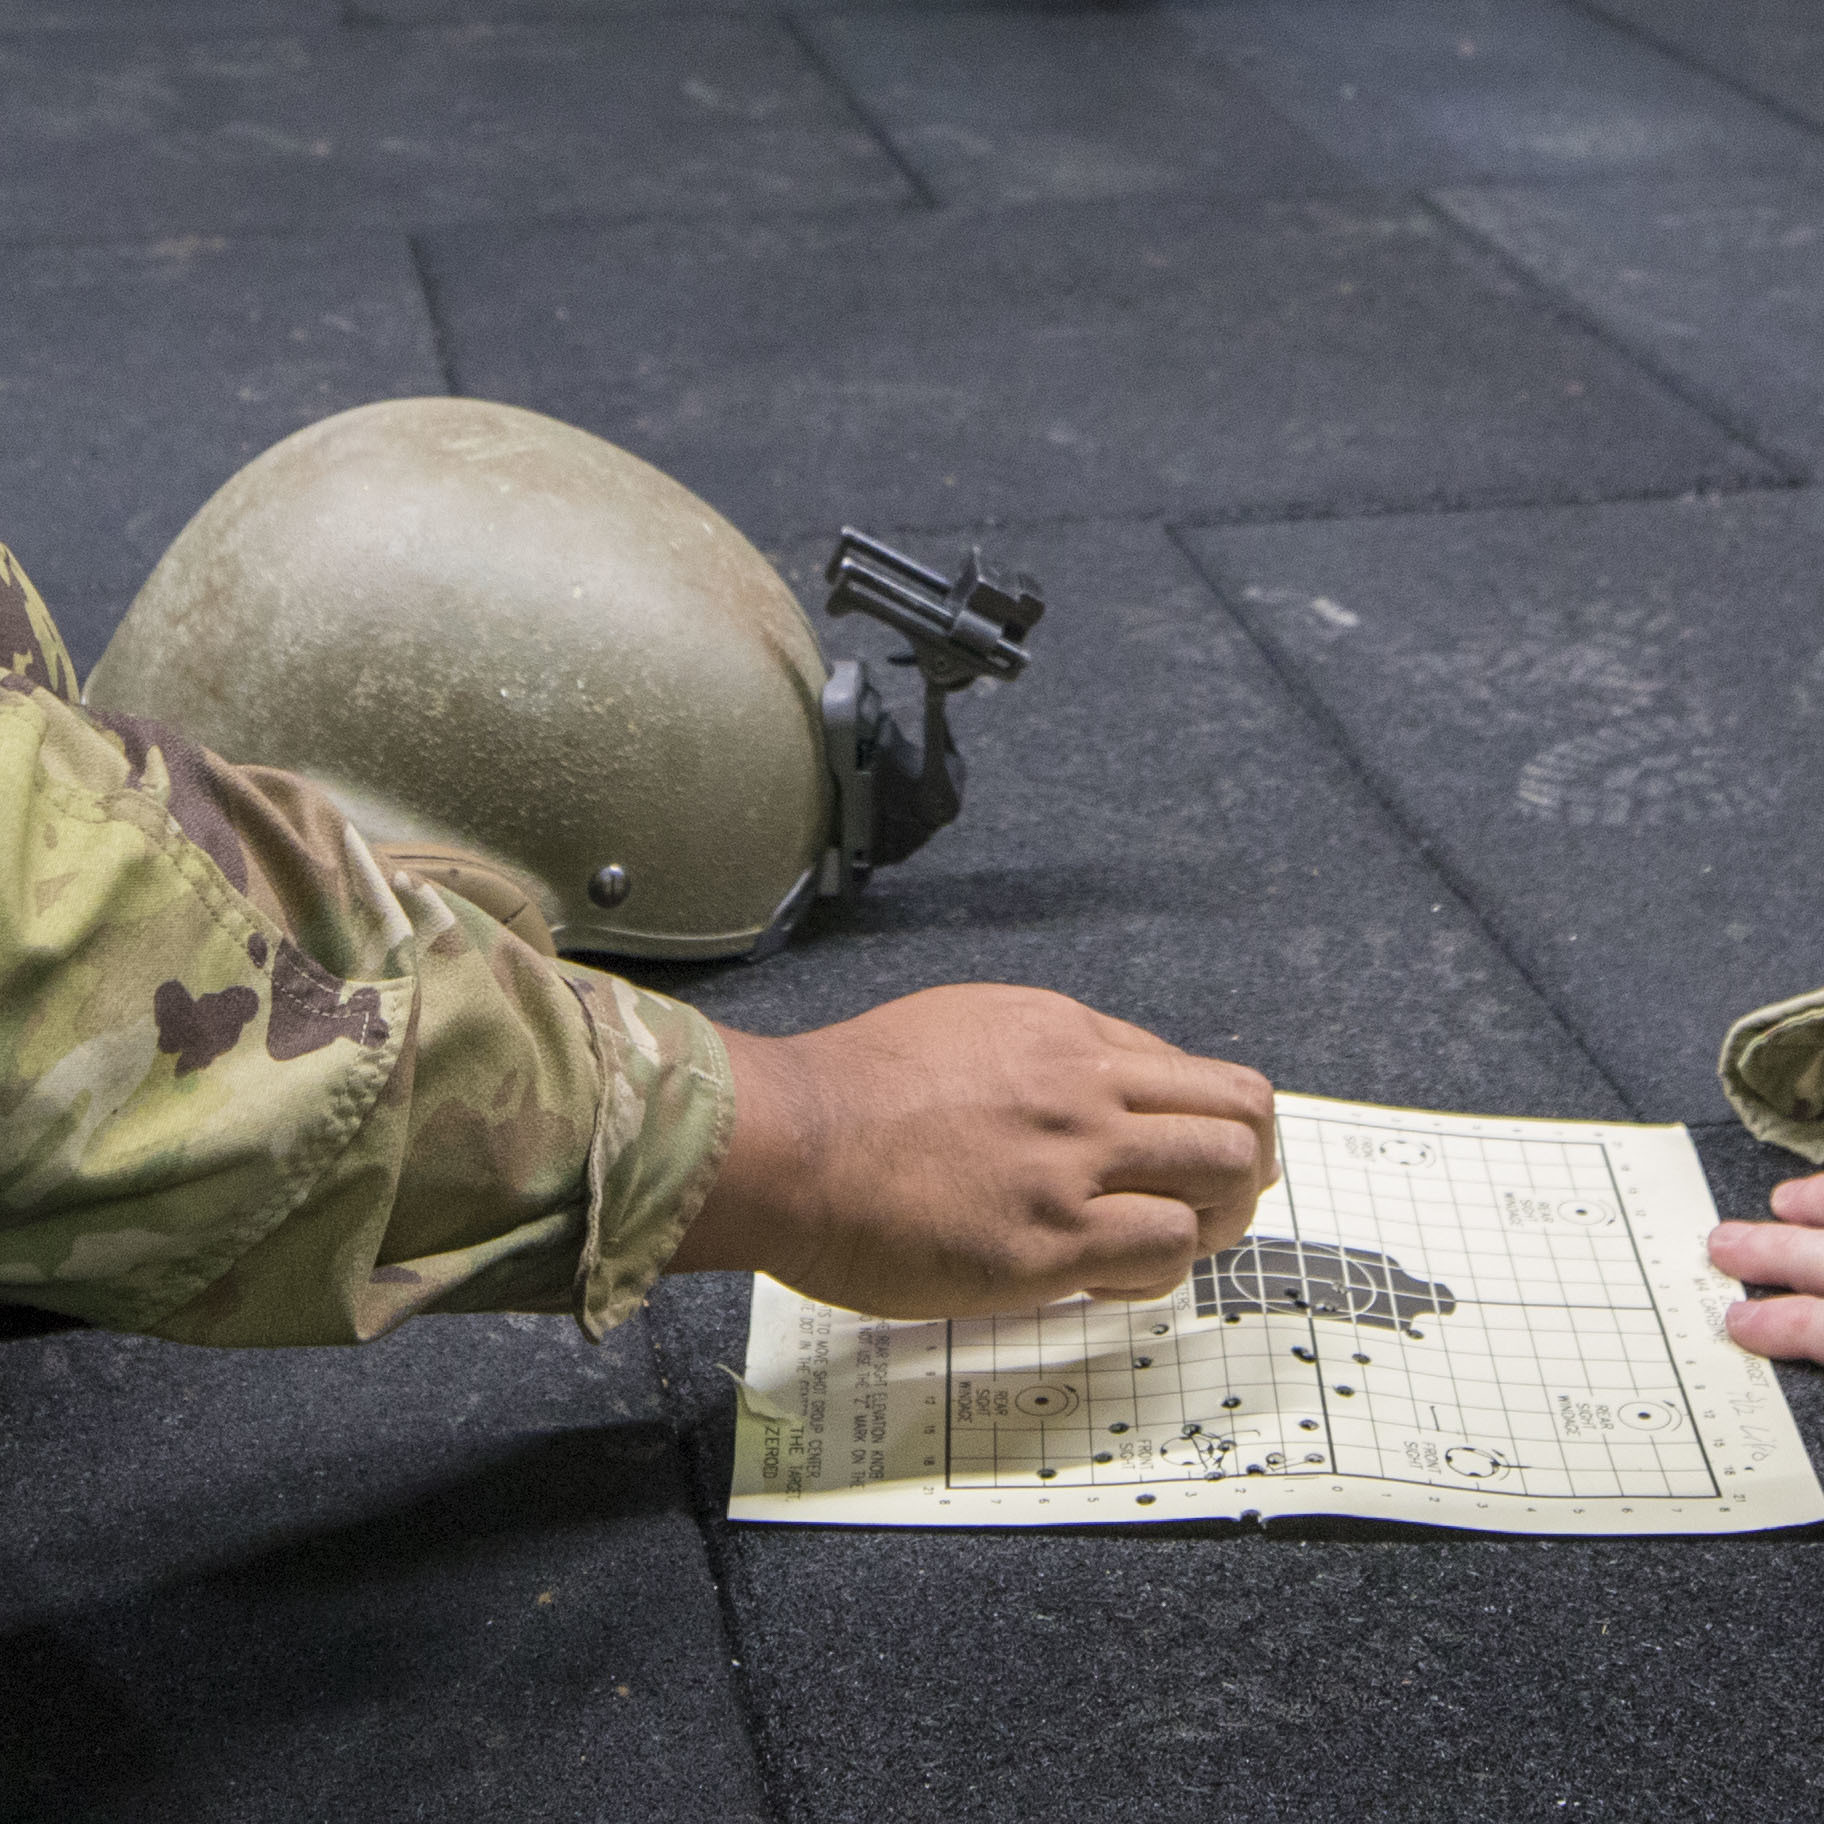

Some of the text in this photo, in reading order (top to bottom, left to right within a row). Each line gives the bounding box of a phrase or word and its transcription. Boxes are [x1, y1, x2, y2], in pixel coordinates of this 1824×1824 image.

[799, 1317, 814, 1335] DOT
[817, 1323, 831, 1335] TO
[857, 1327, 873, 1345] NOT
[799, 1340, 813, 1350] IN
[814, 1340, 829, 1365] MOVE
[797, 1356, 812, 1375] THE
[1743, 1352, 1770, 1389] ARGET
[812, 1370, 828, 1395] SHOT
[855, 1372, 870, 1388] THE
[924, 1395, 937, 1406] 12
[957, 1381, 973, 1424] WINDAGE
[976, 1388, 991, 1418] SIGHT
[994, 1389, 1008, 1417] REAR
[1703, 1409, 1717, 1419] 12
[809, 1399, 826, 1434] GROUP
[852, 1415, 868, 1442] MARK
[870, 1392, 889, 1443] ELEVATION
[1558, 1394, 1582, 1437] WINDAGE
[1577, 1402, 1597, 1431] SIGHT
[1595, 1403, 1615, 1431] REAR
[788, 1426, 804, 1455] THE
[924, 1425, 937, 1436] 15
[1713, 1437, 1726, 1449] 15
[762, 1425, 781, 1480] ZEROED
[806, 1438, 823, 1479] CENTER
[851, 1449, 866, 1465] ON
[869, 1450, 886, 1480] KNOB
[1119, 1442, 1137, 1470] SIGHT
[1137, 1438, 1155, 1471] FRONT
[1404, 1440, 1424, 1471] SIGHT
[1422, 1440, 1442, 1476] FRONT
[849, 1471, 865, 1489] THE
[922, 1486, 936, 1496] 21
[1733, 1493, 1747, 1503] 21
